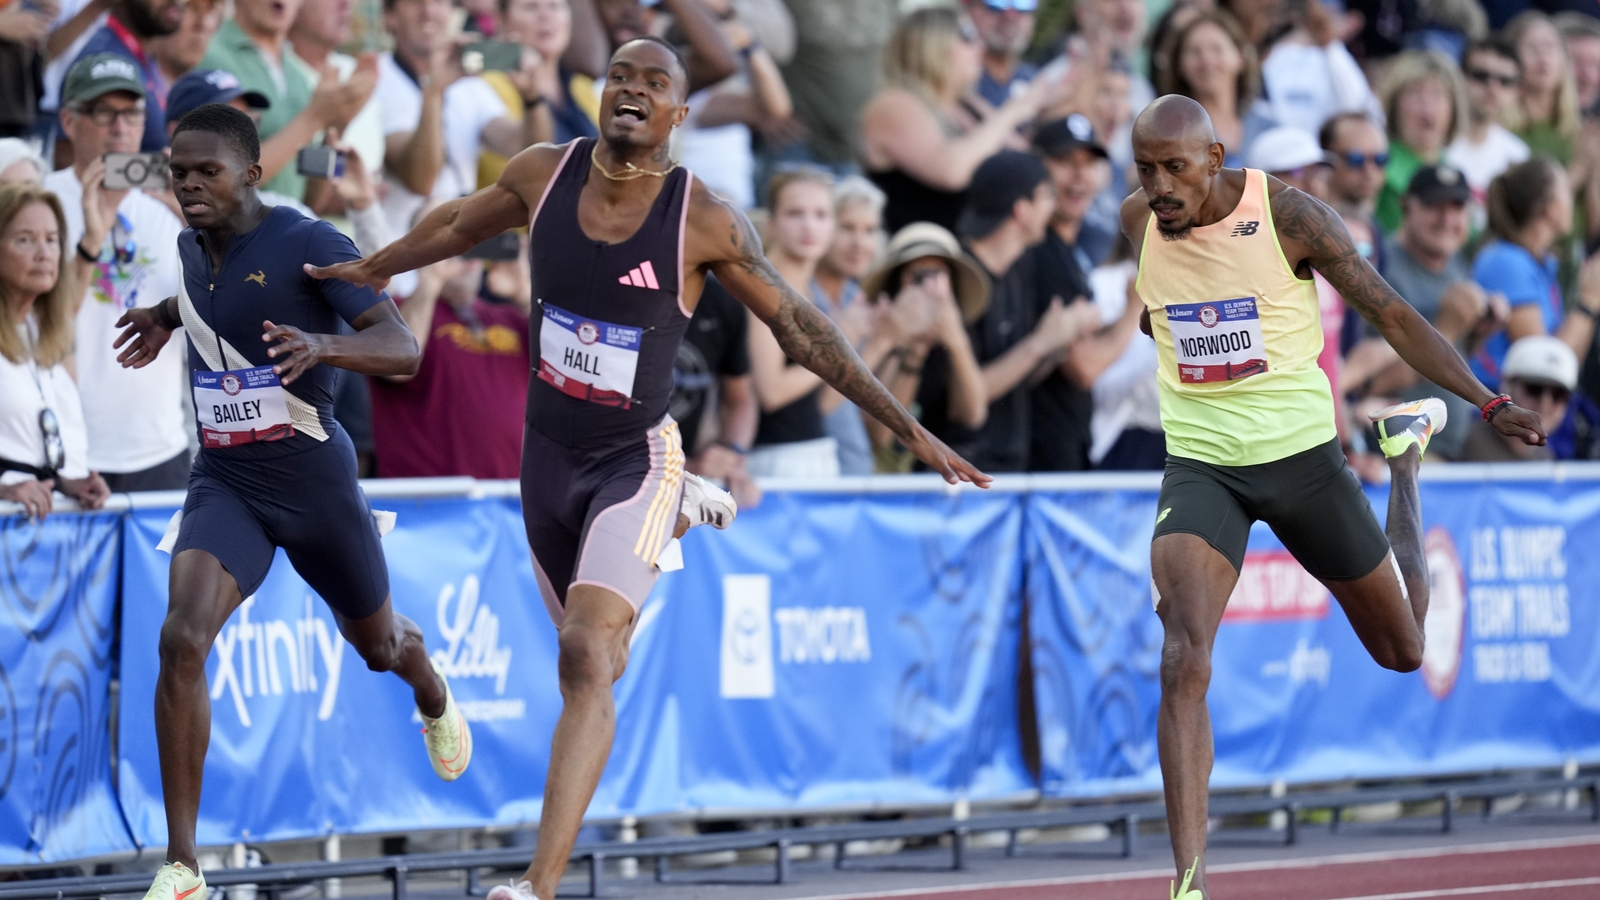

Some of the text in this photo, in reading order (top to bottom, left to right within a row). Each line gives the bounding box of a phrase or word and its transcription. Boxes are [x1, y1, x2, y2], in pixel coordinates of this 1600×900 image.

[563, 346, 601, 376] HALL
[1180, 330, 1252, 358] NORWOOD
[213, 399, 262, 424] BAILEY
[431, 574, 511, 694] Lilly
[775, 606, 871, 664] TOYOTA
[211, 594, 343, 727] xfinity
